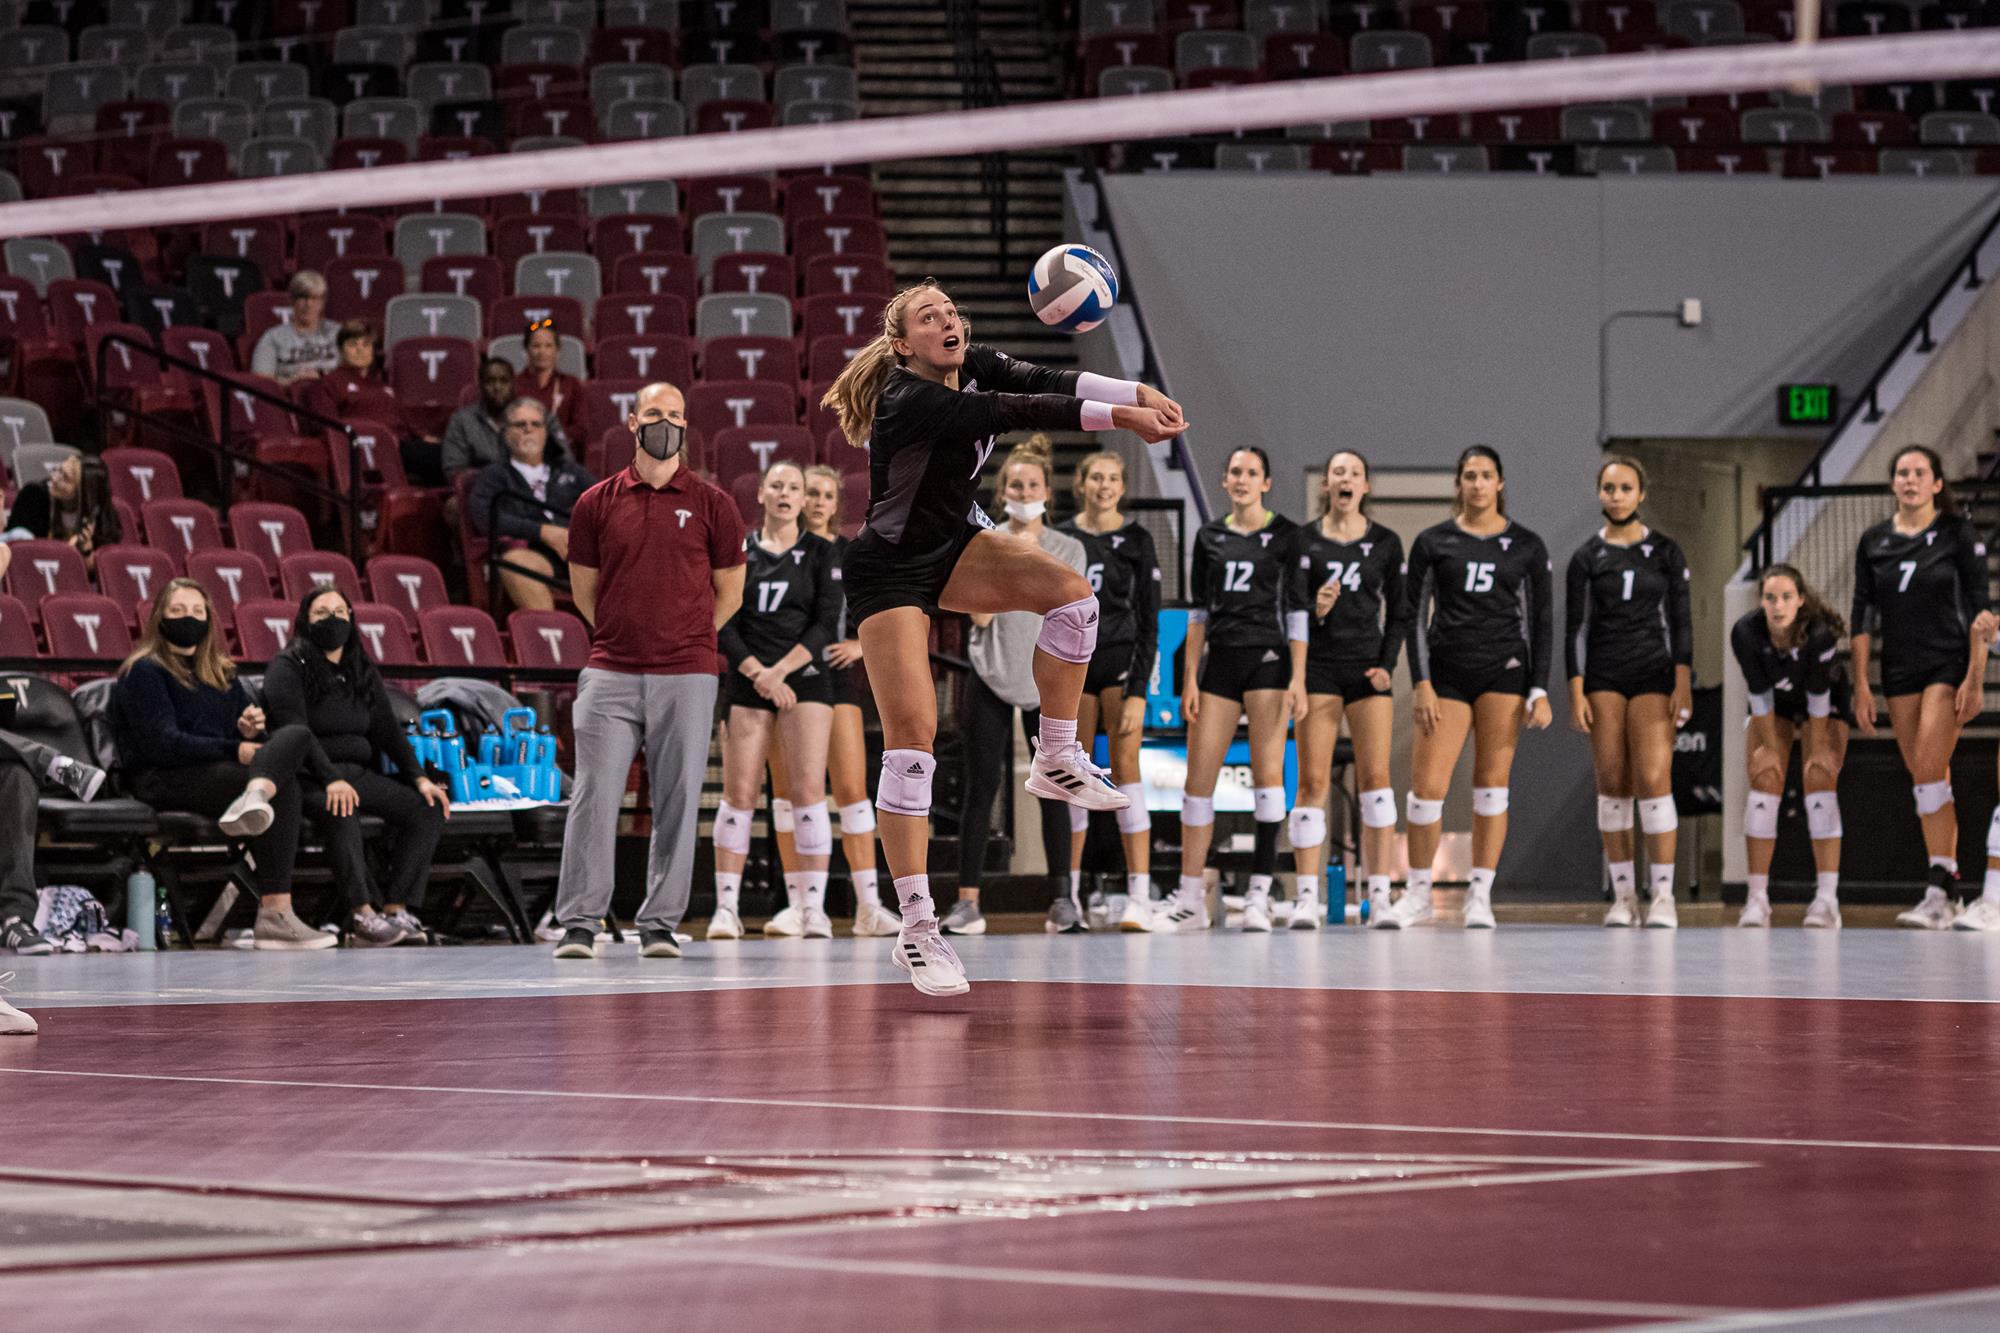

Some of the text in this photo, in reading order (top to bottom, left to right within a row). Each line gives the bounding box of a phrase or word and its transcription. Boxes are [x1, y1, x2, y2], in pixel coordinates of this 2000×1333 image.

[54, 0, 72, 22] T
[217, 0, 236, 23] T
[299, 1, 320, 25] T
[384, 0, 402, 22] T
[467, 2, 485, 24] T
[715, 2, 735, 24] T
[1188, 5, 1209, 28] T
[1354, 6, 1375, 27] T
[1437, 6, 1456, 29] T
[1523, 8, 1544, 31] T
[1607, 8, 1628, 30] T
[1863, 14, 1886, 34] T
[275, 38, 296, 62] T
[445, 38, 467, 62] T
[623, 39, 644, 62] T
[711, 41, 733, 64] T
[799, 40, 820, 64] T
[1117, 43, 1136, 68] T
[1293, 45, 1313, 67] T
[1470, 43, 1491, 63] T
[347, 75, 369, 97] T
[530, 75, 551, 99] T
[1889, 86, 1911, 110] T
[1973, 89, 1994, 113] T
[122, 113, 141, 136] T
[457, 112, 479, 137] T
[545, 112, 567, 139] T
[723, 112, 745, 132] T
[1409, 117, 1429, 139] T
[1500, 117, 1520, 140] T
[1682, 119, 1702, 141] T
[1861, 123, 1882, 143] T
[44, 149, 66, 174] T
[177, 152, 199, 176] T
[270, 152, 289, 174] T
[1529, 152, 1551, 173] T
[1718, 155, 1740, 174] T
[1812, 156, 1835, 175] T
[524, 191, 546, 214] T
[622, 190, 643, 212] T
[718, 188, 742, 214] T
[817, 187, 840, 212] T
[231, 230, 255, 255] T
[329, 229, 353, 256] T
[429, 229, 452, 254] T
[528, 227, 552, 253] T
[627, 225, 651, 252] T
[727, 228, 751, 251] T
[826, 228, 850, 254] T
[30, 254, 49, 287] T
[103, 260, 122, 288] T
[215, 268, 238, 296] T
[354, 270, 378, 297] T
[449, 269, 474, 295] T
[546, 269, 570, 294] T
[642, 267, 667, 294] T
[740, 266, 766, 293] T
[834, 267, 859, 293] T
[0, 291, 18, 320] T
[75, 294, 96, 322] T
[153, 299, 174, 328] T
[422, 308, 446, 334] T
[627, 306, 652, 334] T
[732, 308, 757, 334] T
[837, 307, 862, 335] T
[189, 342, 209, 368] T
[420, 351, 446, 380] T
[630, 347, 656, 375] T
[738, 350, 764, 377] T
[235, 391, 254, 421] T
[611, 393, 638, 423] T
[726, 399, 753, 427] T
[1790, 385, 1829, 420] EXIT
[2, 417, 24, 447] T
[354, 436, 375, 467] T
[750, 442, 778, 471] T
[130, 467, 154, 500] T
[171, 517, 194, 552] T
[260, 521, 284, 556] T
[35, 560, 59, 594] T
[127, 566, 151, 600] T
[217, 568, 242, 603] T
[1224, 561, 1254, 592] 12
[1326, 561, 1361, 592] 24
[1465, 562, 1495, 592] 15
[1622, 570, 1635, 600] 1
[1899, 561, 1916, 592] 7
[398, 575, 421, 609] T
[758, 581, 789, 612] 17
[74, 615, 100, 651] T
[265, 619, 289, 648] T
[360, 624, 385, 660] T
[451, 628, 475, 662] T
[539, 628, 562, 662] T
[8, 679, 29, 708] T
